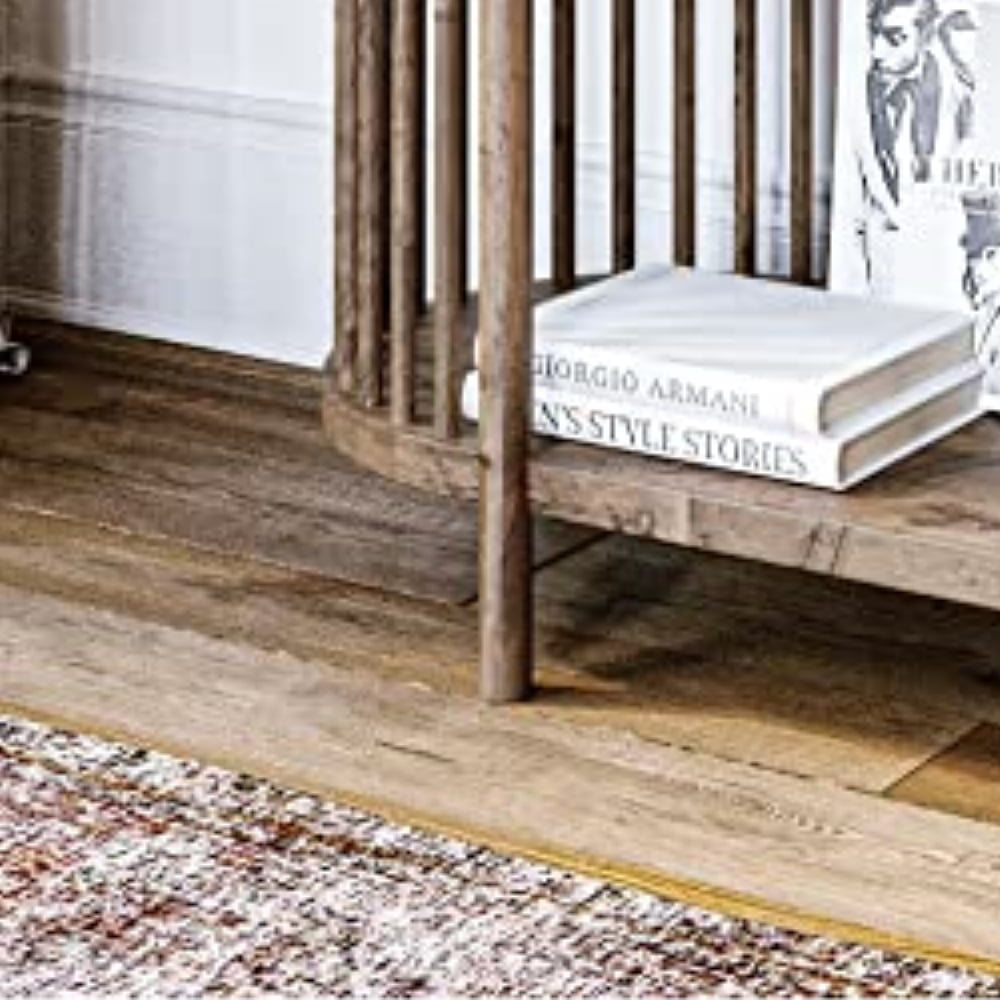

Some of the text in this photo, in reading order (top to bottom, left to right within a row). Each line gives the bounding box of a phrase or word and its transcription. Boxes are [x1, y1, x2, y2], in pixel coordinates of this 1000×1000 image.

[649, 376, 761, 419] ARMANI
[588, 409, 677, 455] STYLE
[683, 428, 809, 476] STORIES
